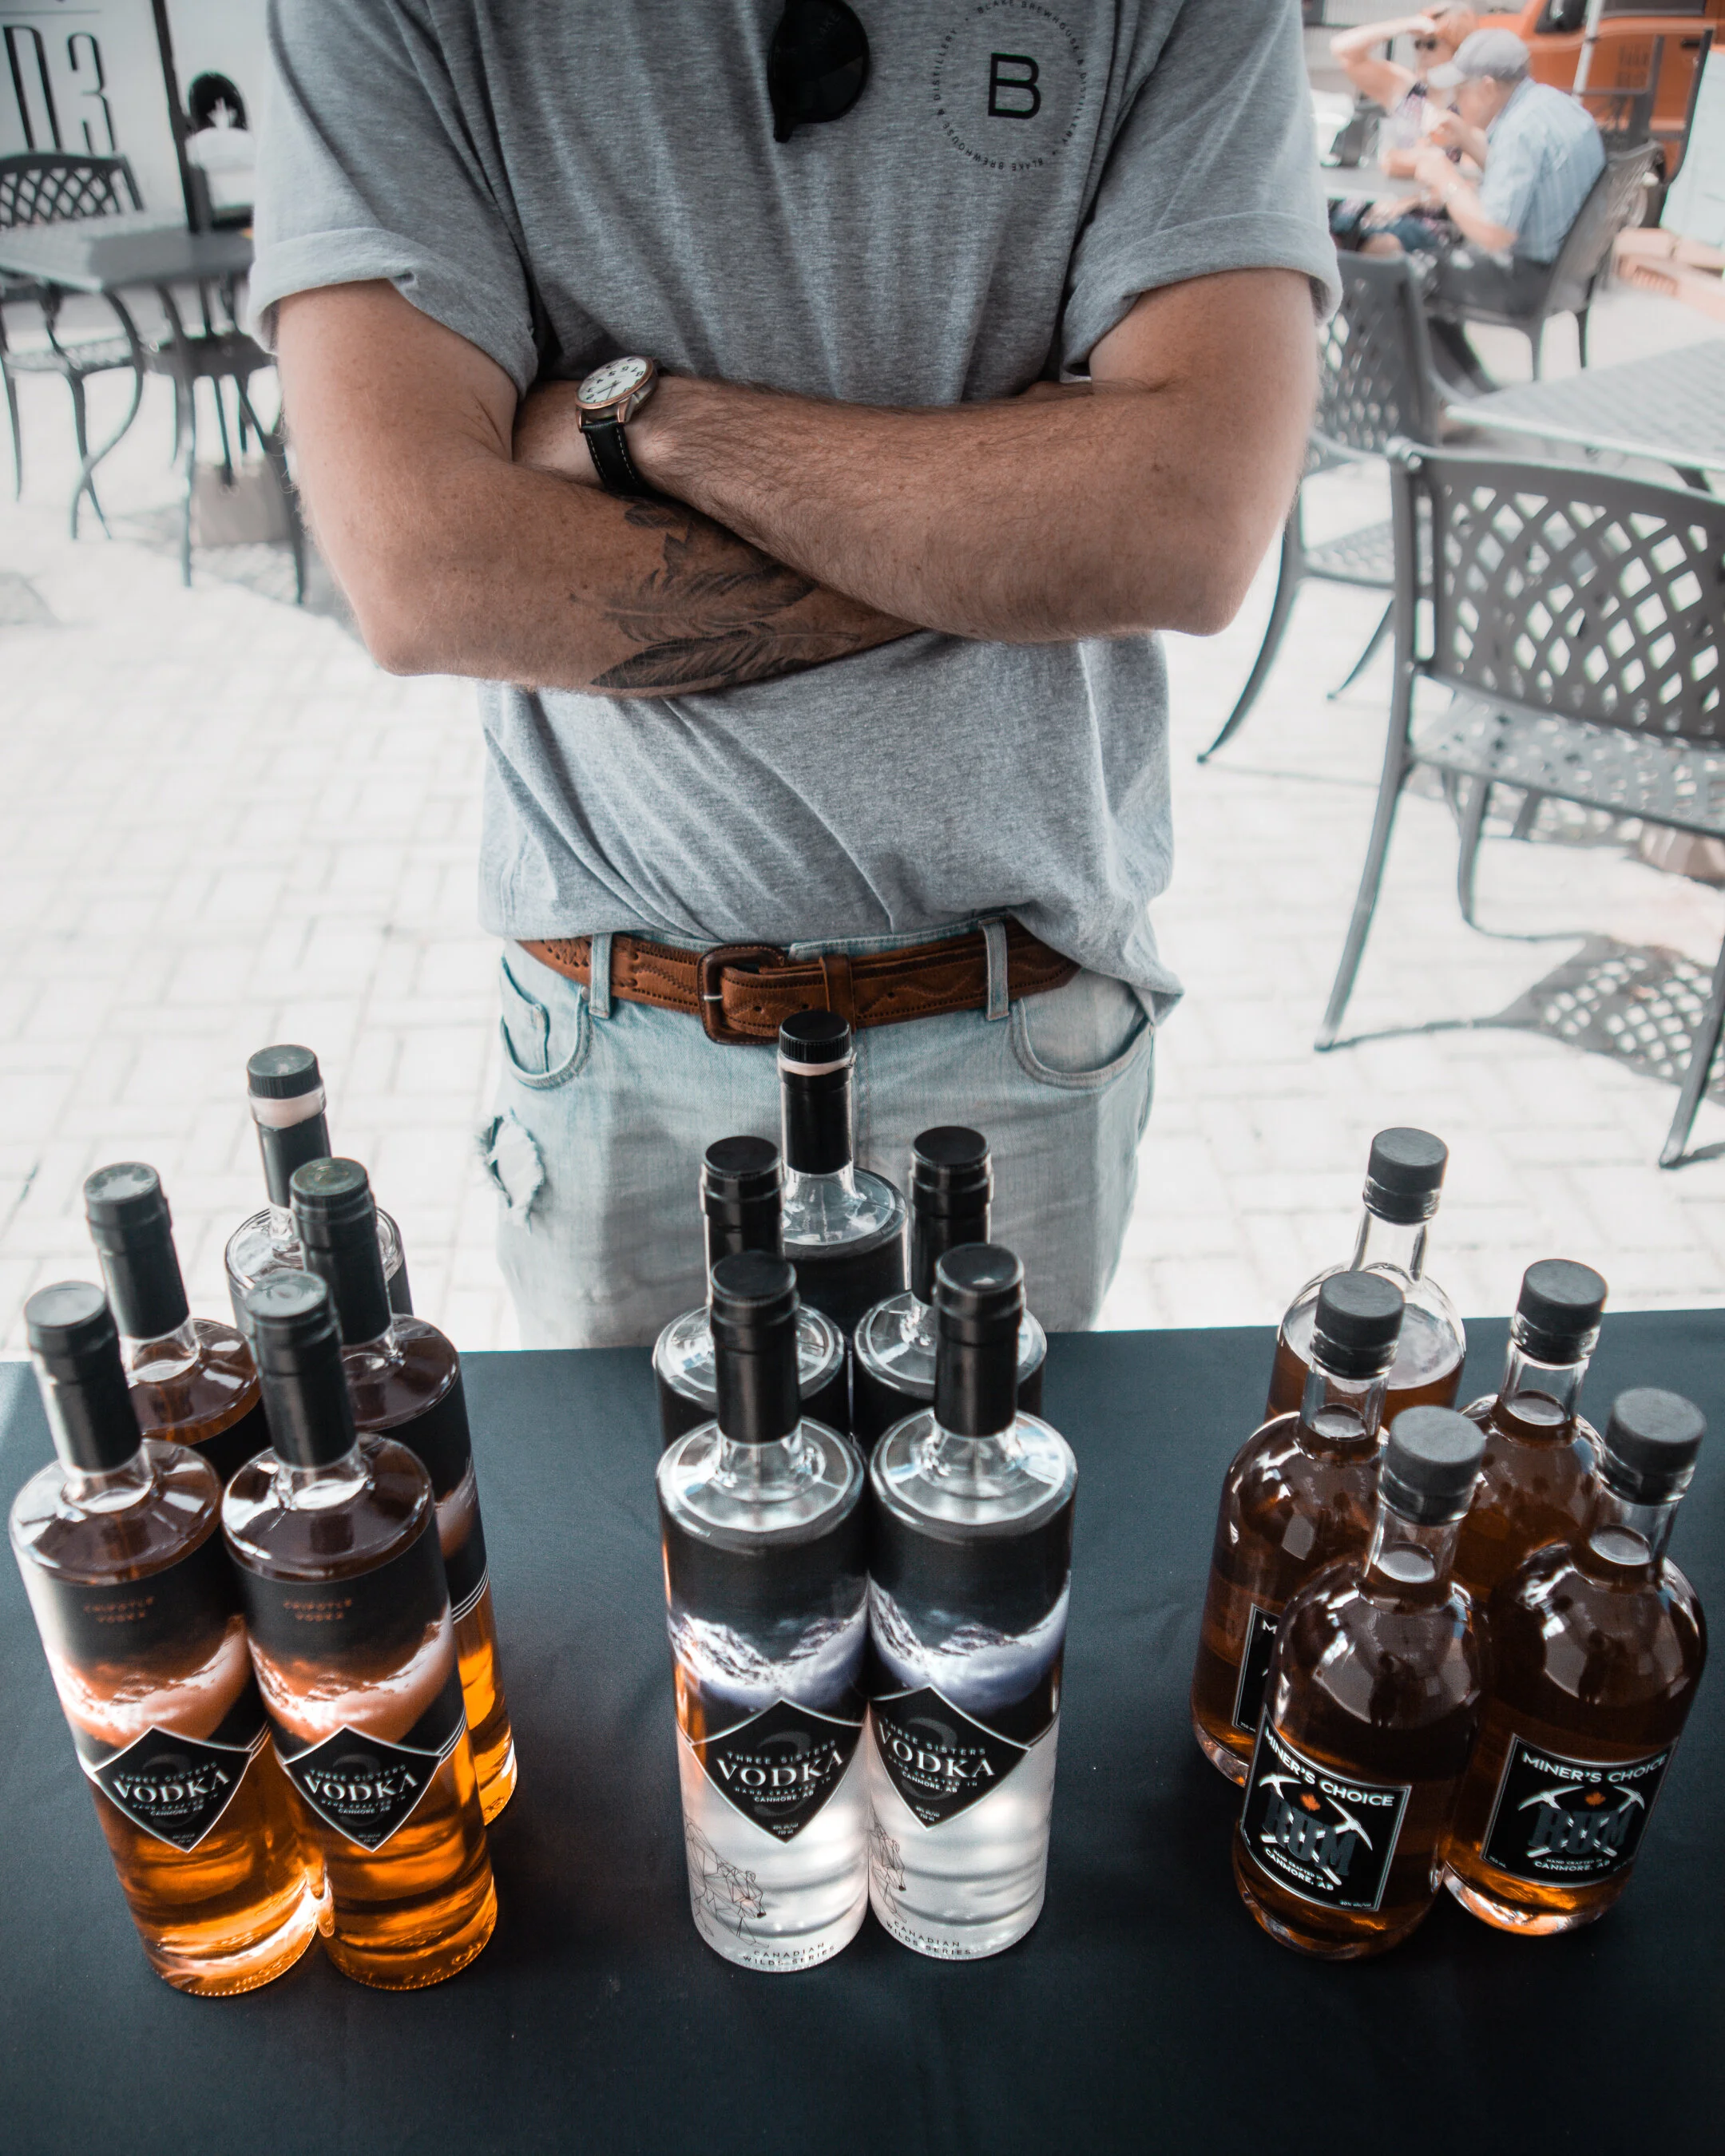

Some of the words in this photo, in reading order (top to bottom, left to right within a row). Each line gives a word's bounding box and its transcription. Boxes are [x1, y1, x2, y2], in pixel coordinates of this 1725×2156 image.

[1021, 1, 1080, 53] BREWHOUSE
[932, 28, 958, 101] DISTILLERY
[988, 52, 1041, 120] B
[942, 121, 1005, 170] BREWHOUSE
[1010, 157, 1044, 172] BLAKE
[878, 1722, 995, 1778] VODKA
[884, 1718, 918, 1745] THREE
[926, 1742, 985, 1756] SISTERS
[728, 1751, 771, 1765] THREE
[781, 1740, 835, 1764] SISTERS
[1264, 1726, 1316, 1785] MINER'S
[1319, 1779, 1395, 1807] CHOICE
[120, 1773, 157, 1783] THREE
[310, 1769, 347, 1782] THREE
[355, 1764, 406, 1781] SISTERS
[717, 1750, 843, 1787] VODKA
[914, 1770, 960, 1786] CRAFTED
[1523, 1751, 1602, 1783] MINER'S
[1608, 1754, 1668, 1783] CHOICE
[113, 1770, 230, 1803] VODKA
[304, 1773, 418, 1801] VODKA
[735, 1785, 762, 1796] HAND
[769, 1783, 816, 1796] CRAFTED
[803, 1789, 814, 1798] AB
[1262, 1787, 1360, 1877] RUM
[1528, 1801, 1639, 1855] RUM
[1288, 1859, 1315, 1877] CRAFTED
[1596, 1858, 1610, 1869] AB
[1317, 1881, 1334, 1891] AB
[886, 1920, 918, 1946] WILDS
[926, 1945, 971, 1955] SERIES
[894, 1920, 960, 1947] CANADIAN
[743, 1956, 784, 1966] WILDS
[791, 1946, 835, 1965] SERIES
[754, 1942, 824, 1958] CANADIAN
